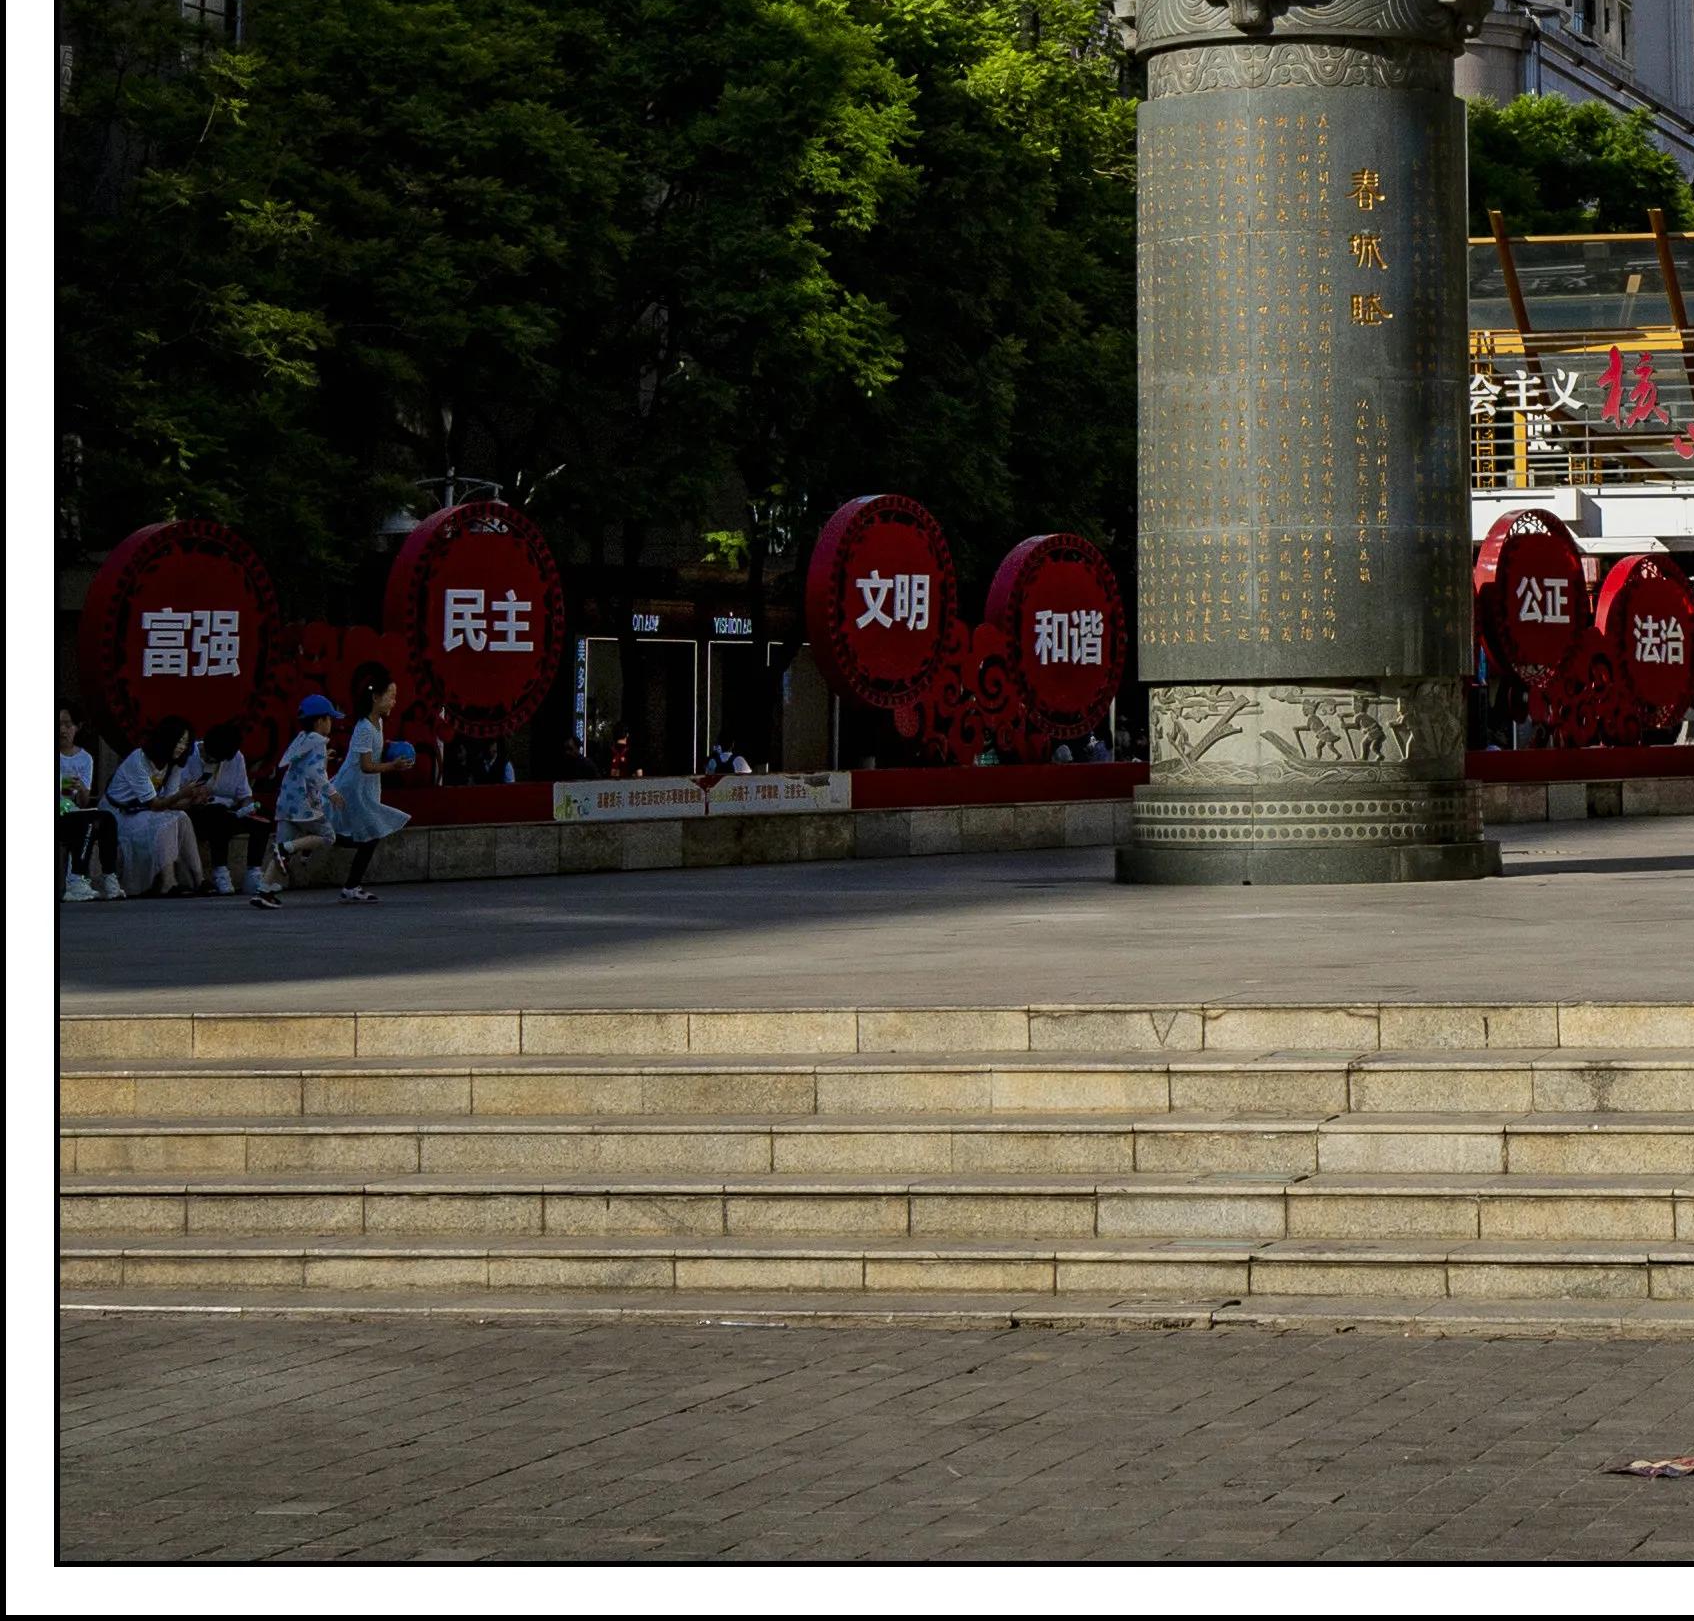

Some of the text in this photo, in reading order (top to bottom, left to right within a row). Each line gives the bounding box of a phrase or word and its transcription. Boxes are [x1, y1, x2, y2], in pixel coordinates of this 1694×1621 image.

[442, 588, 535, 653] 民主
[855, 569, 931, 632] 文明
[1515, 575, 1571, 625] 公正
[141, 607, 241, 678] 富强
[1034, 609, 1105, 665] 和谐
[1632, 613, 1687, 666] 法治
